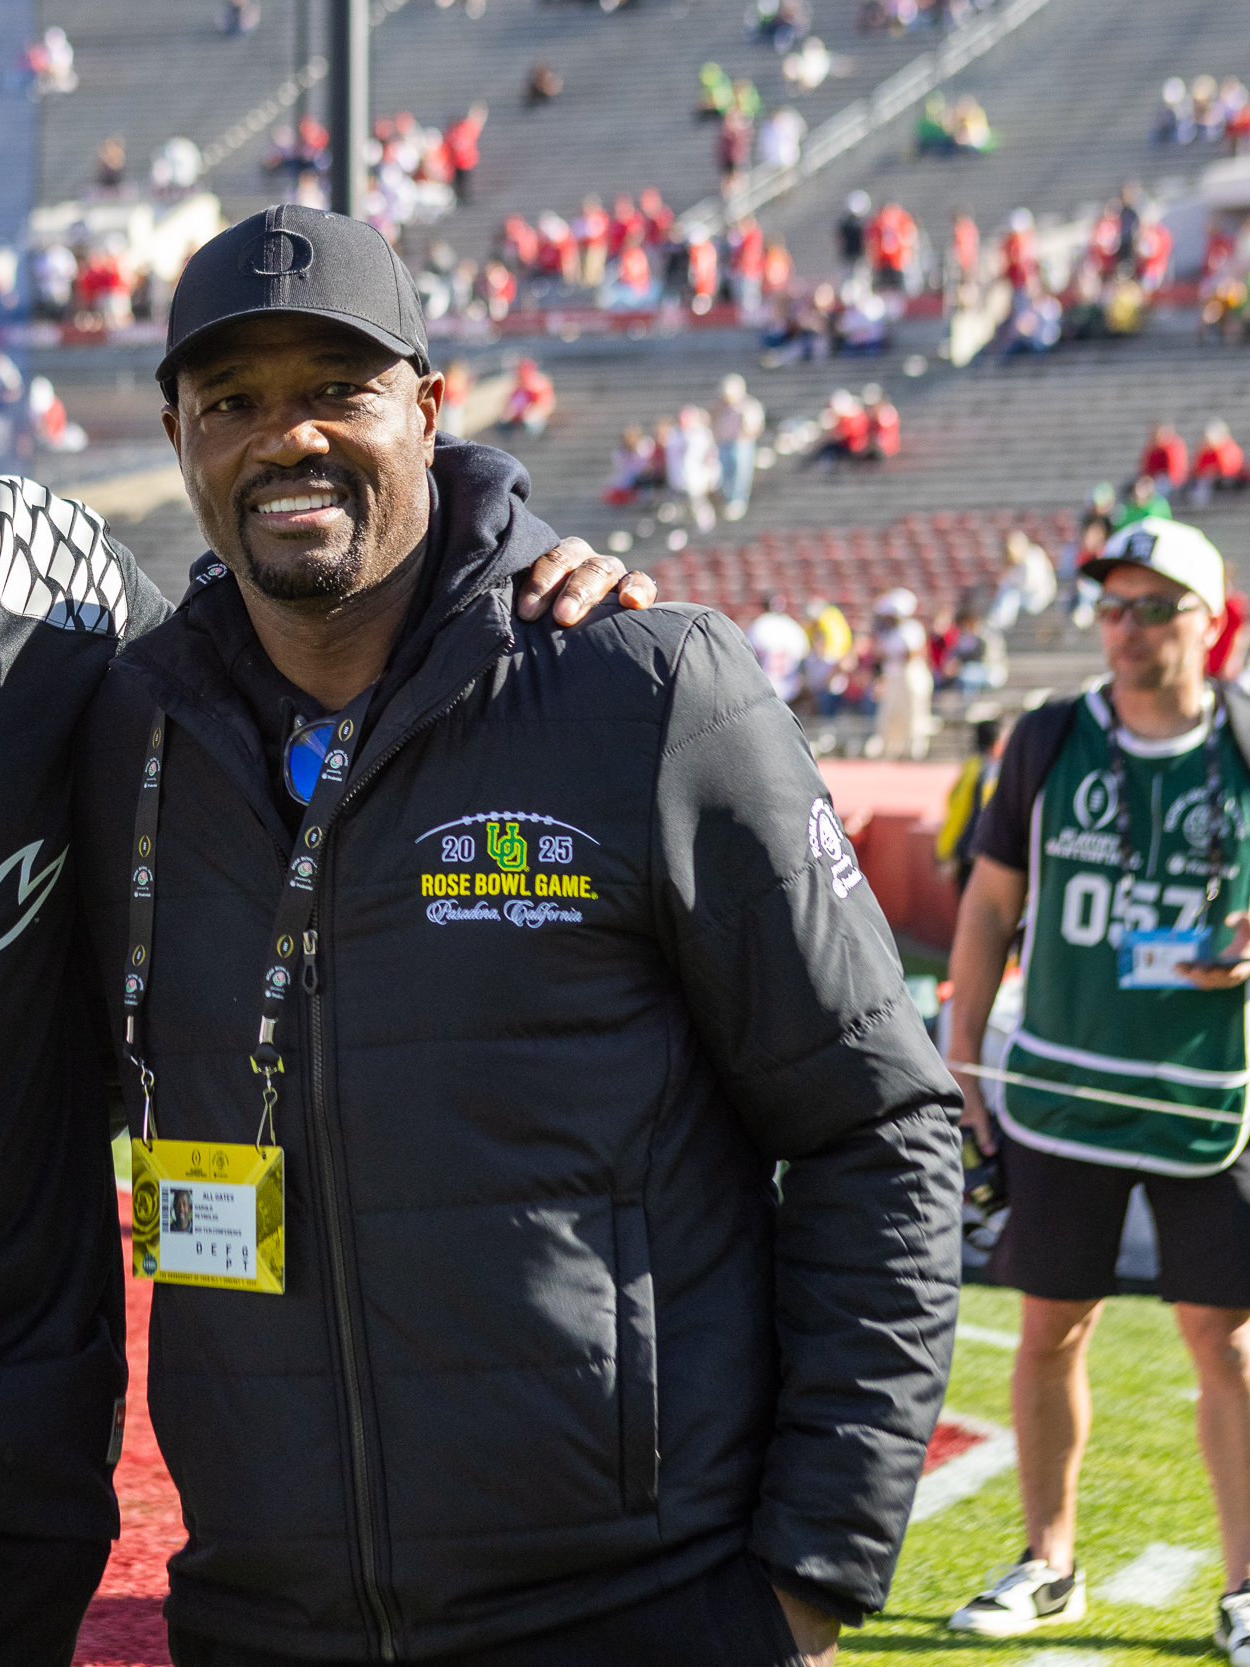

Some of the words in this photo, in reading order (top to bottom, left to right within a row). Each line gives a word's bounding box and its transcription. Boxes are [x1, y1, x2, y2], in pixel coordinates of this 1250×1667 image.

[441, 835, 476, 863] 20
[538, 835, 573, 864] 25
[421, 873, 471, 897] ROSE
[474, 873, 532, 897] BOWL
[534, 873, 592, 898] GAME
[425, 899, 502, 926] Pasadena,
[503, 899, 583, 929] California
